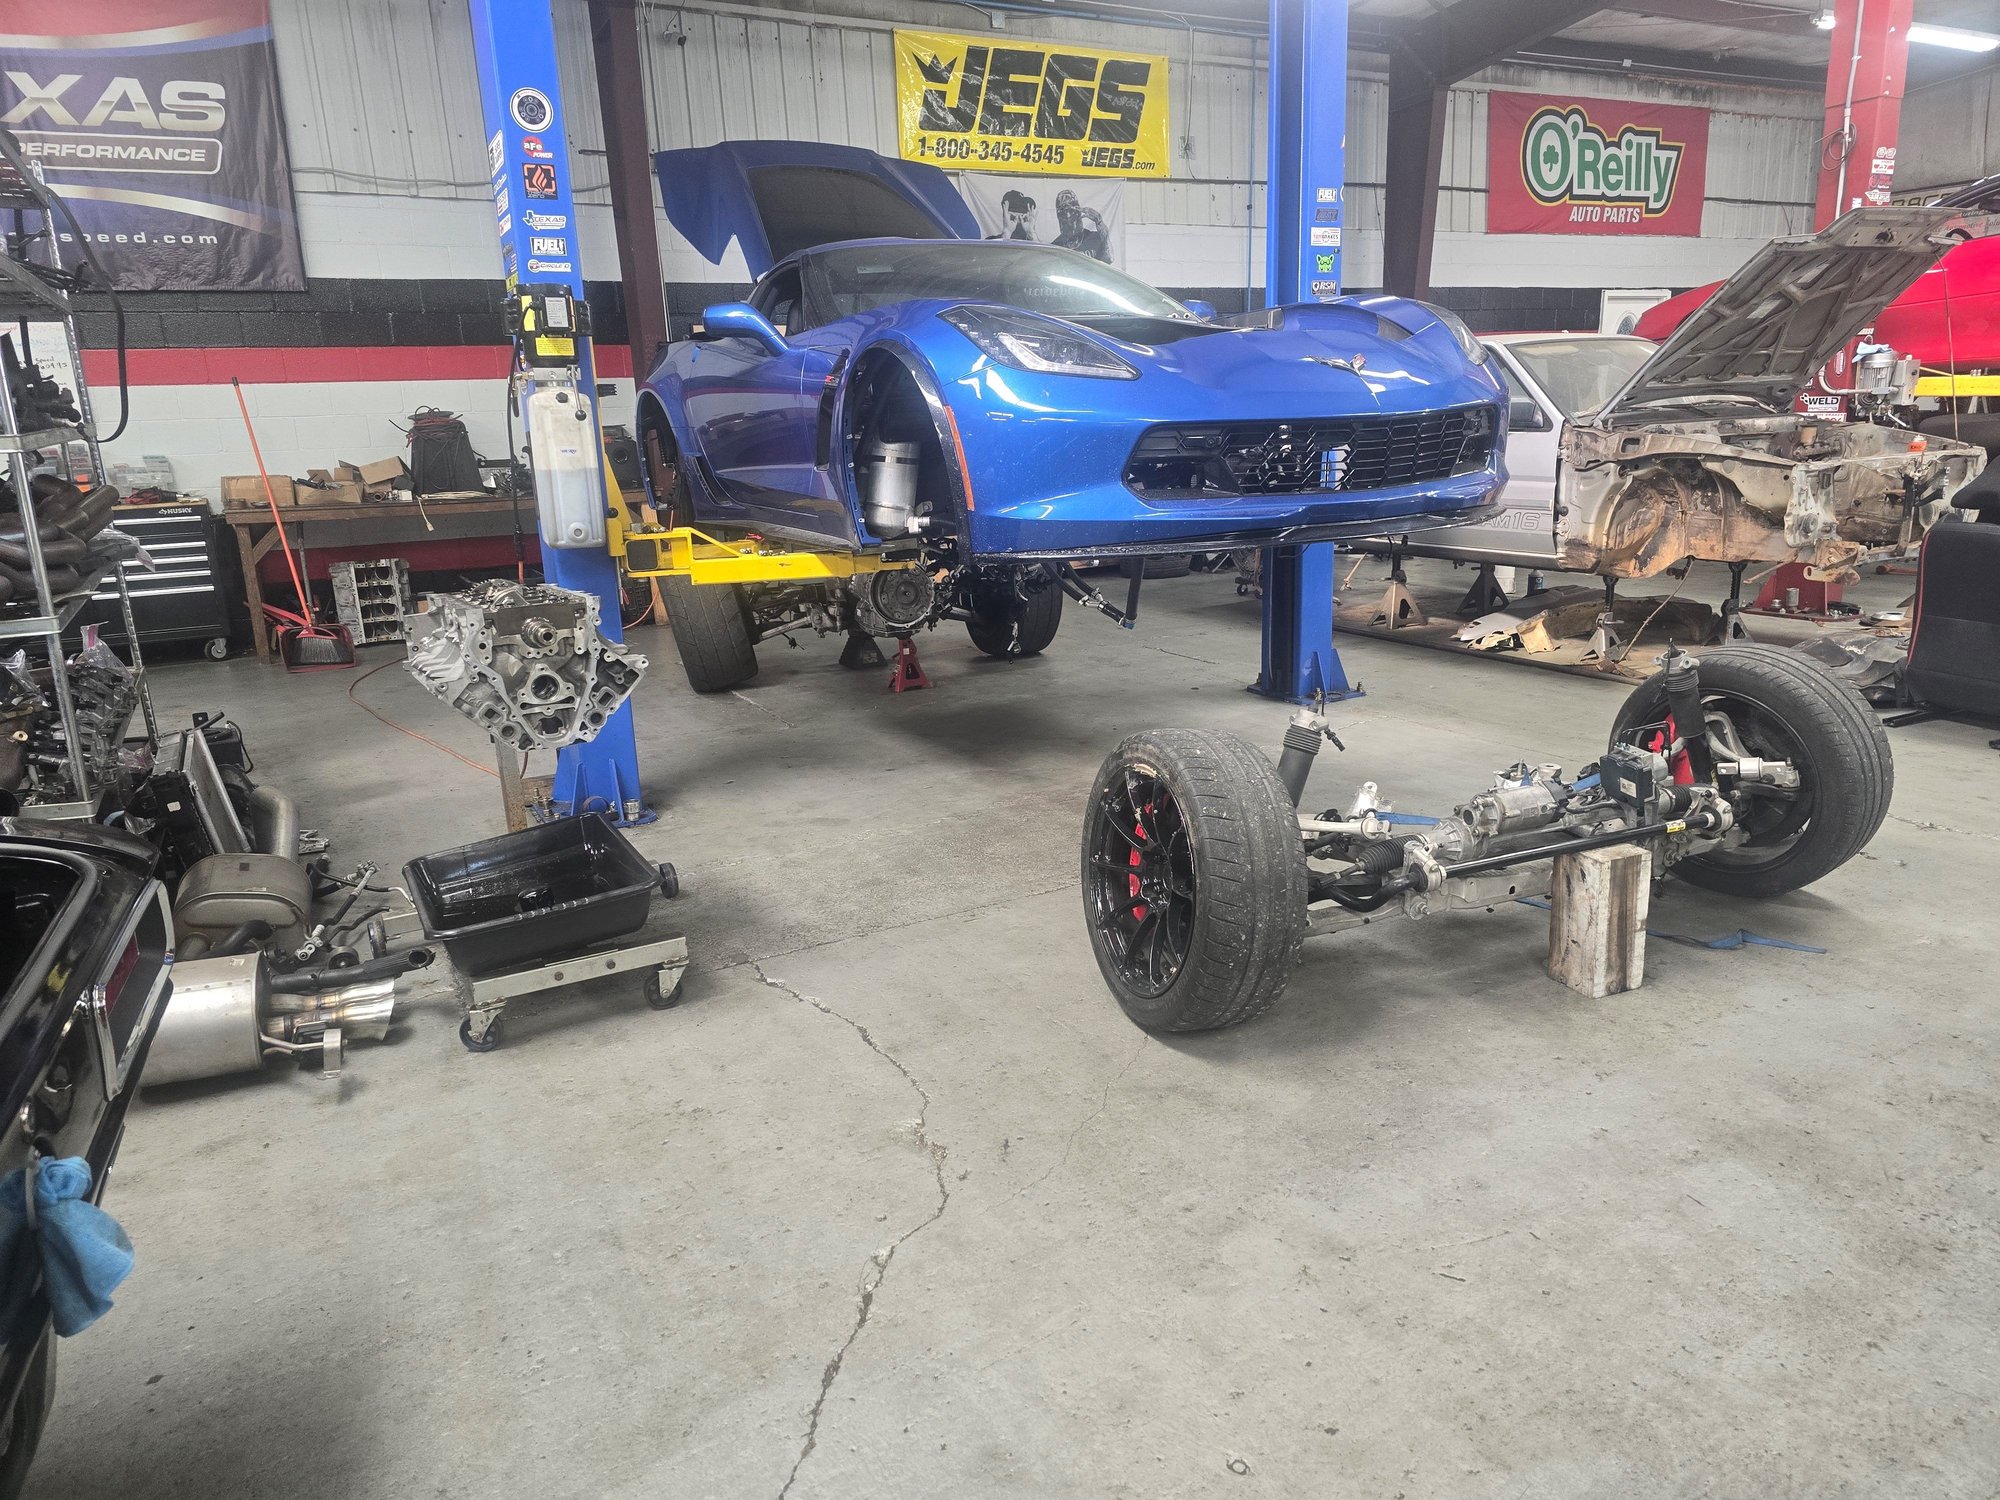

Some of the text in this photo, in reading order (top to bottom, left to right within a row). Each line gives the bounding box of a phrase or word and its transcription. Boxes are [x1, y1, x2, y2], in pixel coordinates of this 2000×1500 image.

[912, 45, 1151, 143] JEGS
[918, 136, 1064, 164] 1-800-345-4545
[1081, 147, 1155, 171] JEGS.com
[1531, 121, 1673, 203] O'Reilly
[1569, 206, 1640, 223] AUTO PARTS
[1809, 397, 1839, 405] WELD
[167, 507, 192, 515] HUSKY
